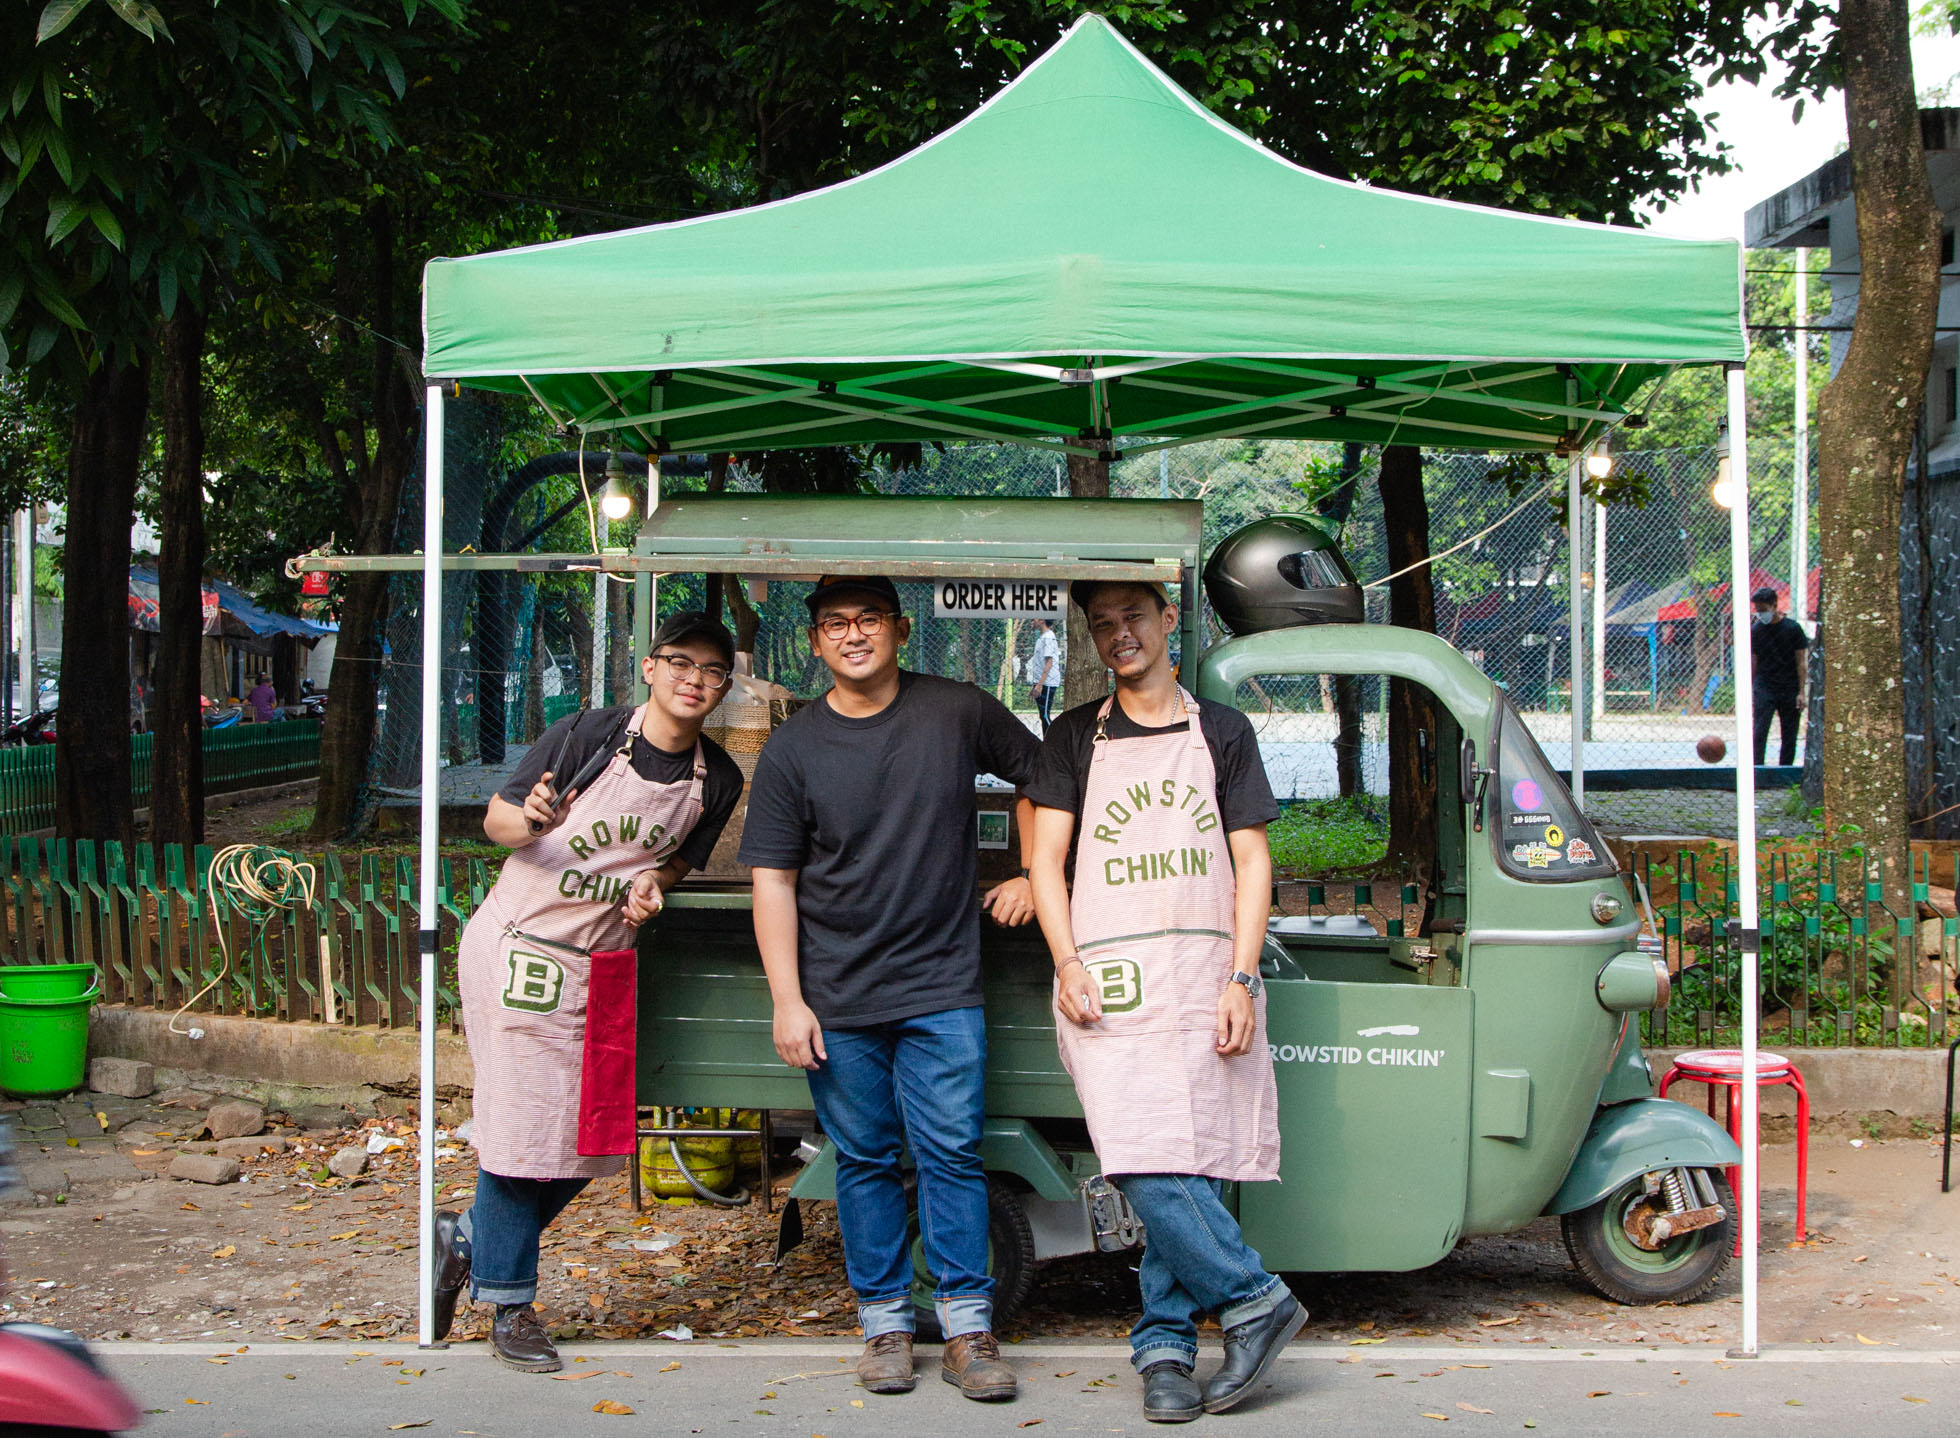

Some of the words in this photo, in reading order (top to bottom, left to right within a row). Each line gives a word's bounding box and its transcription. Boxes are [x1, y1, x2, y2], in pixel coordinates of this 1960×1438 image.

[942, 582, 1006, 610] ORDER
[1012, 583, 1058, 612] HERE
[1104, 847, 1215, 886] CHIKIN'
[503, 950, 565, 1013] B
[1268, 1044, 1362, 1065] ROWSTID
[1366, 1047, 1446, 1067] CHIKIN'
